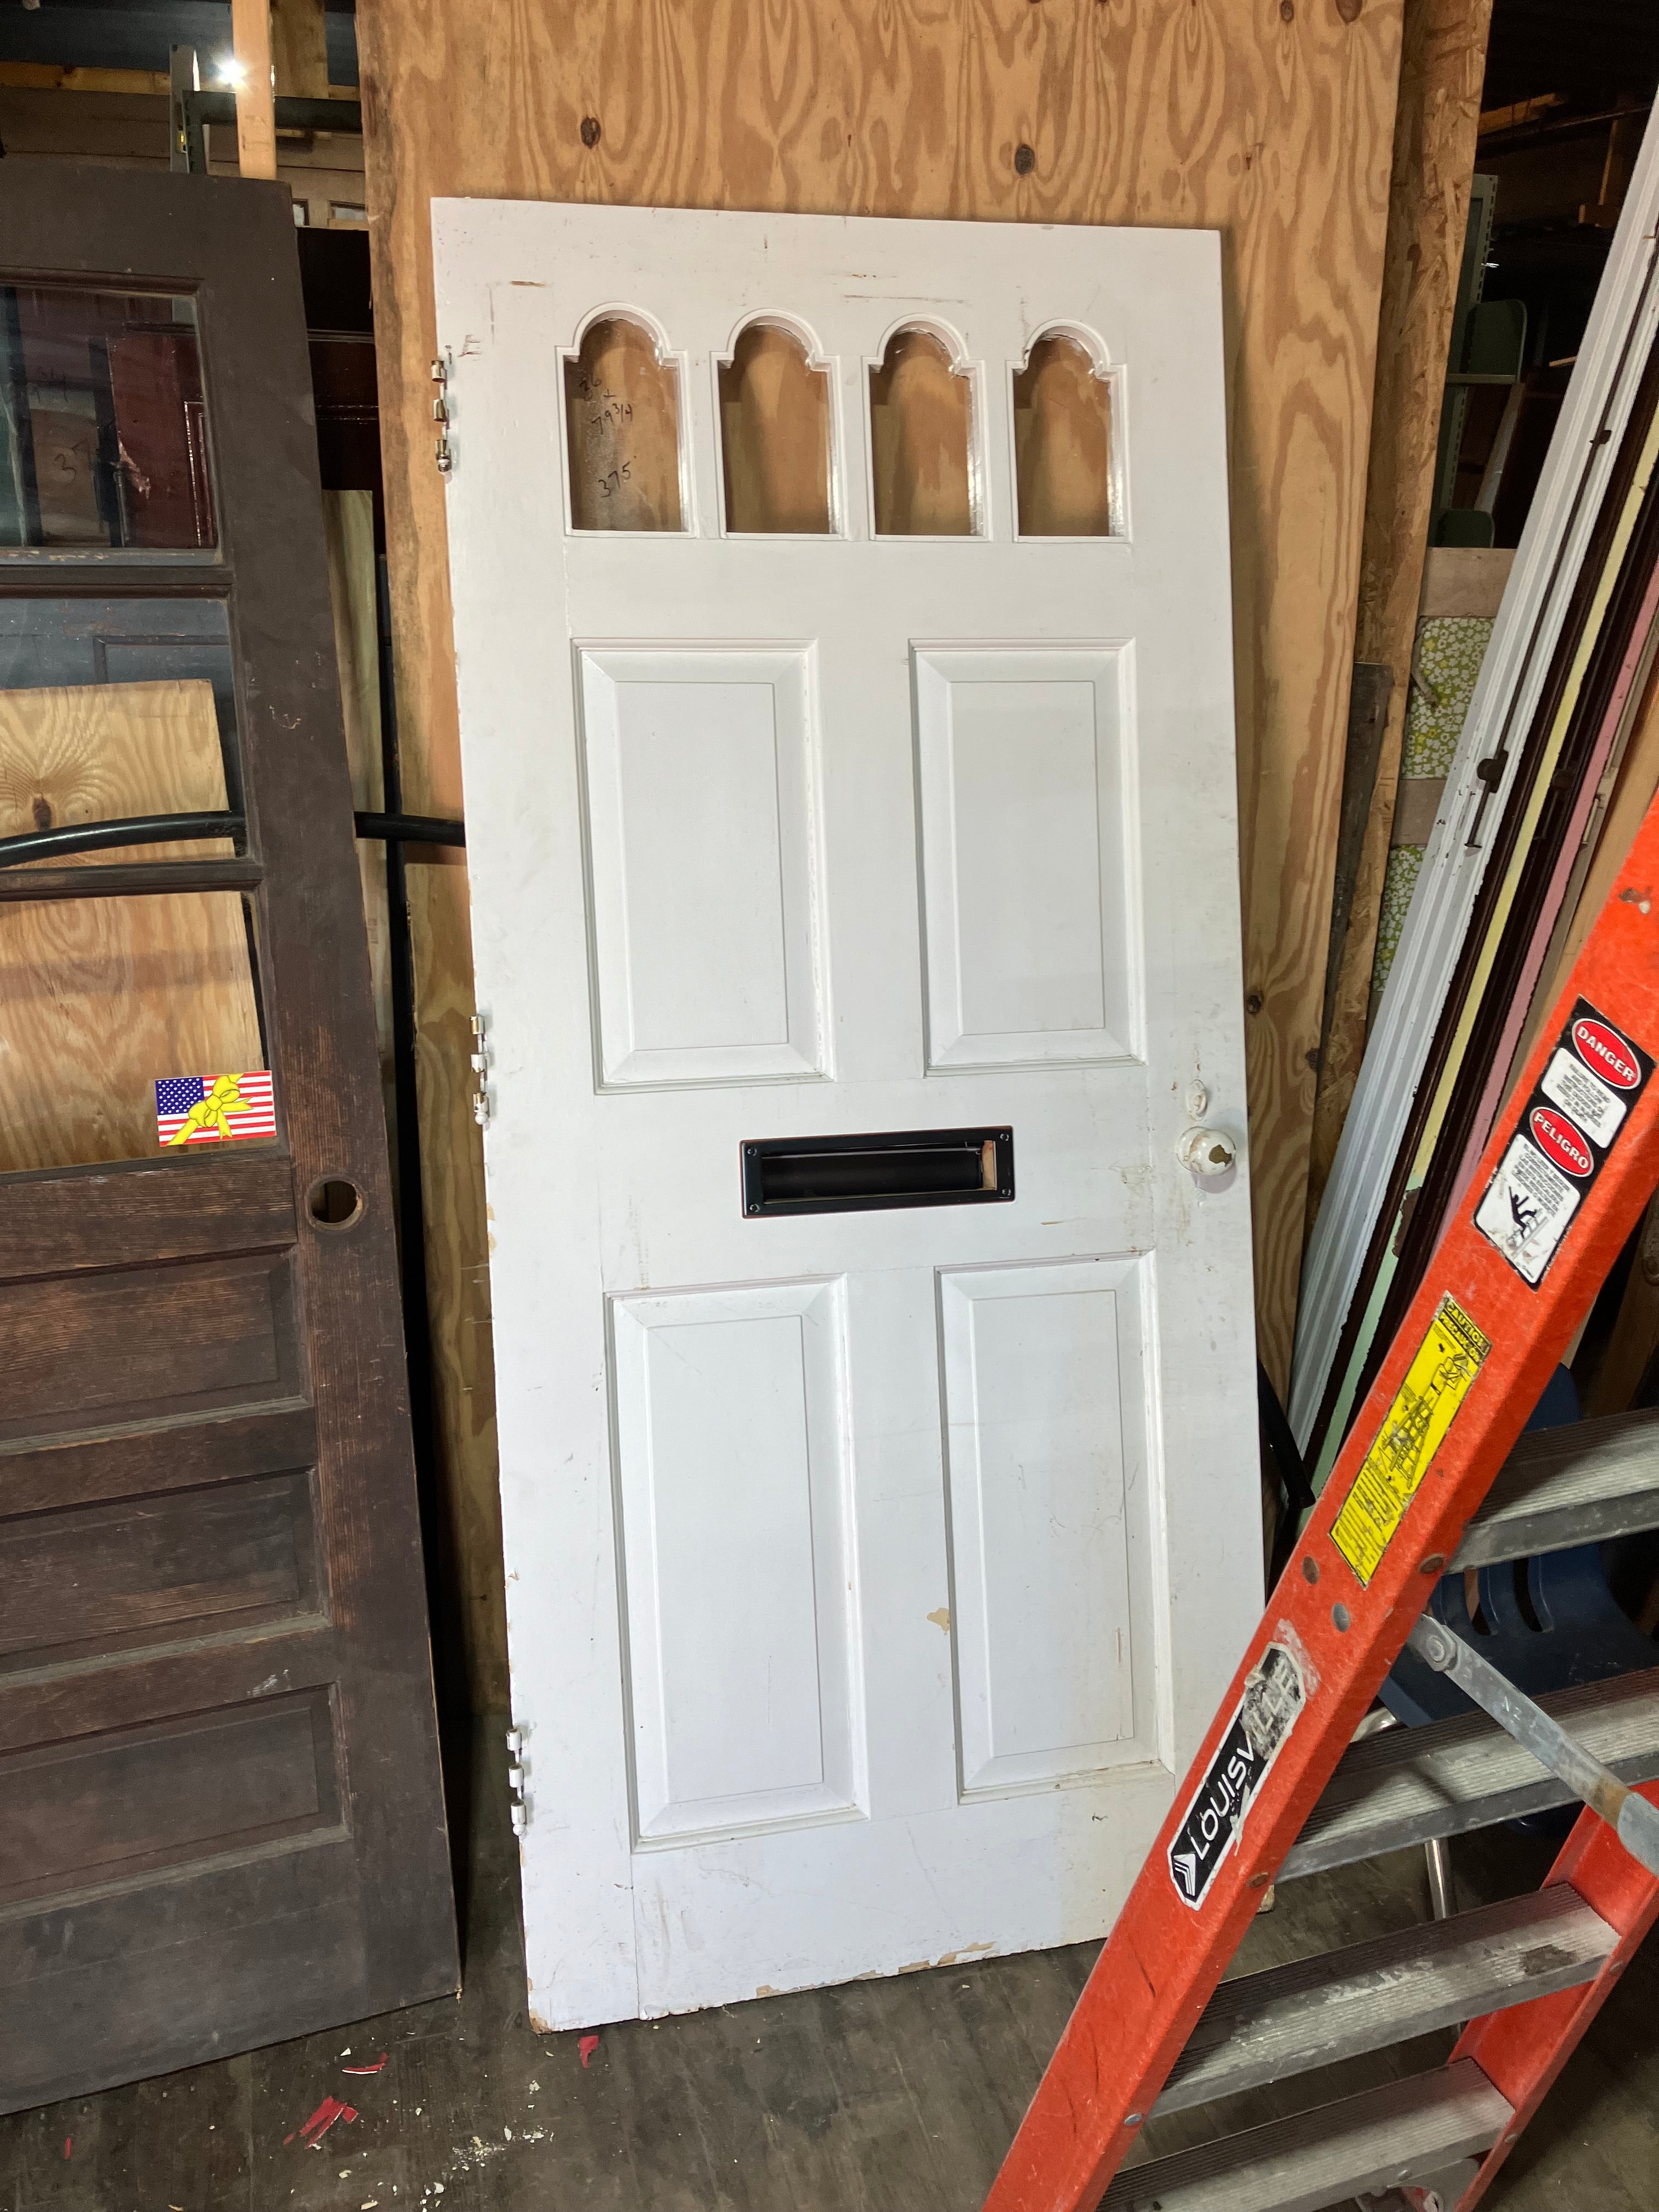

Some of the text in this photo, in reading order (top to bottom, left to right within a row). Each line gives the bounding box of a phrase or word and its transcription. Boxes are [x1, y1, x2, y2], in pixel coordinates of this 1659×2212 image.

[598, 461, 631, 498] 375
[1576, 1025, 1636, 1082] DANGER
[1533, 1113, 1590, 1169] PELIGRO
